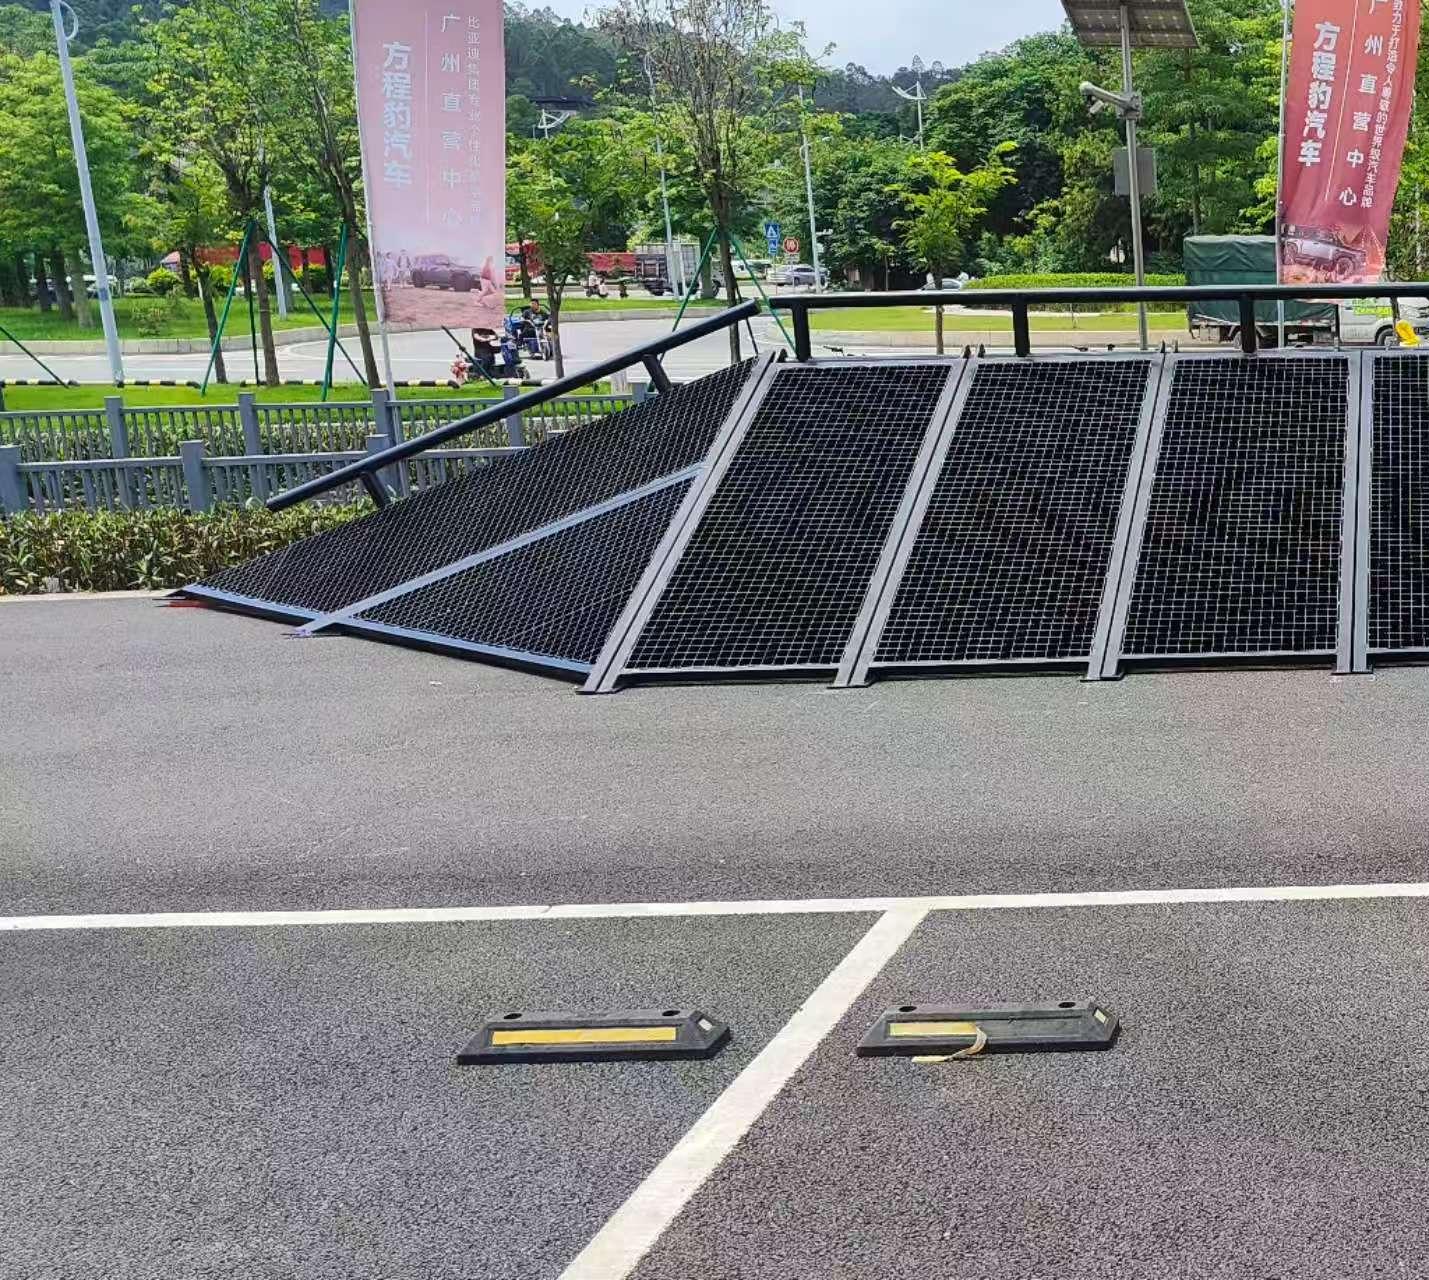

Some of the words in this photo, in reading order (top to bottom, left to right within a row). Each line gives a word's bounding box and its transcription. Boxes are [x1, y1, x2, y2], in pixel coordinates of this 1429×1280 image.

[383, 41, 412, 188] 方程豹汽车
[1297, 21, 1340, 167] 方程豹汽车
[1339, 0, 1388, 206] 广州直营中心
